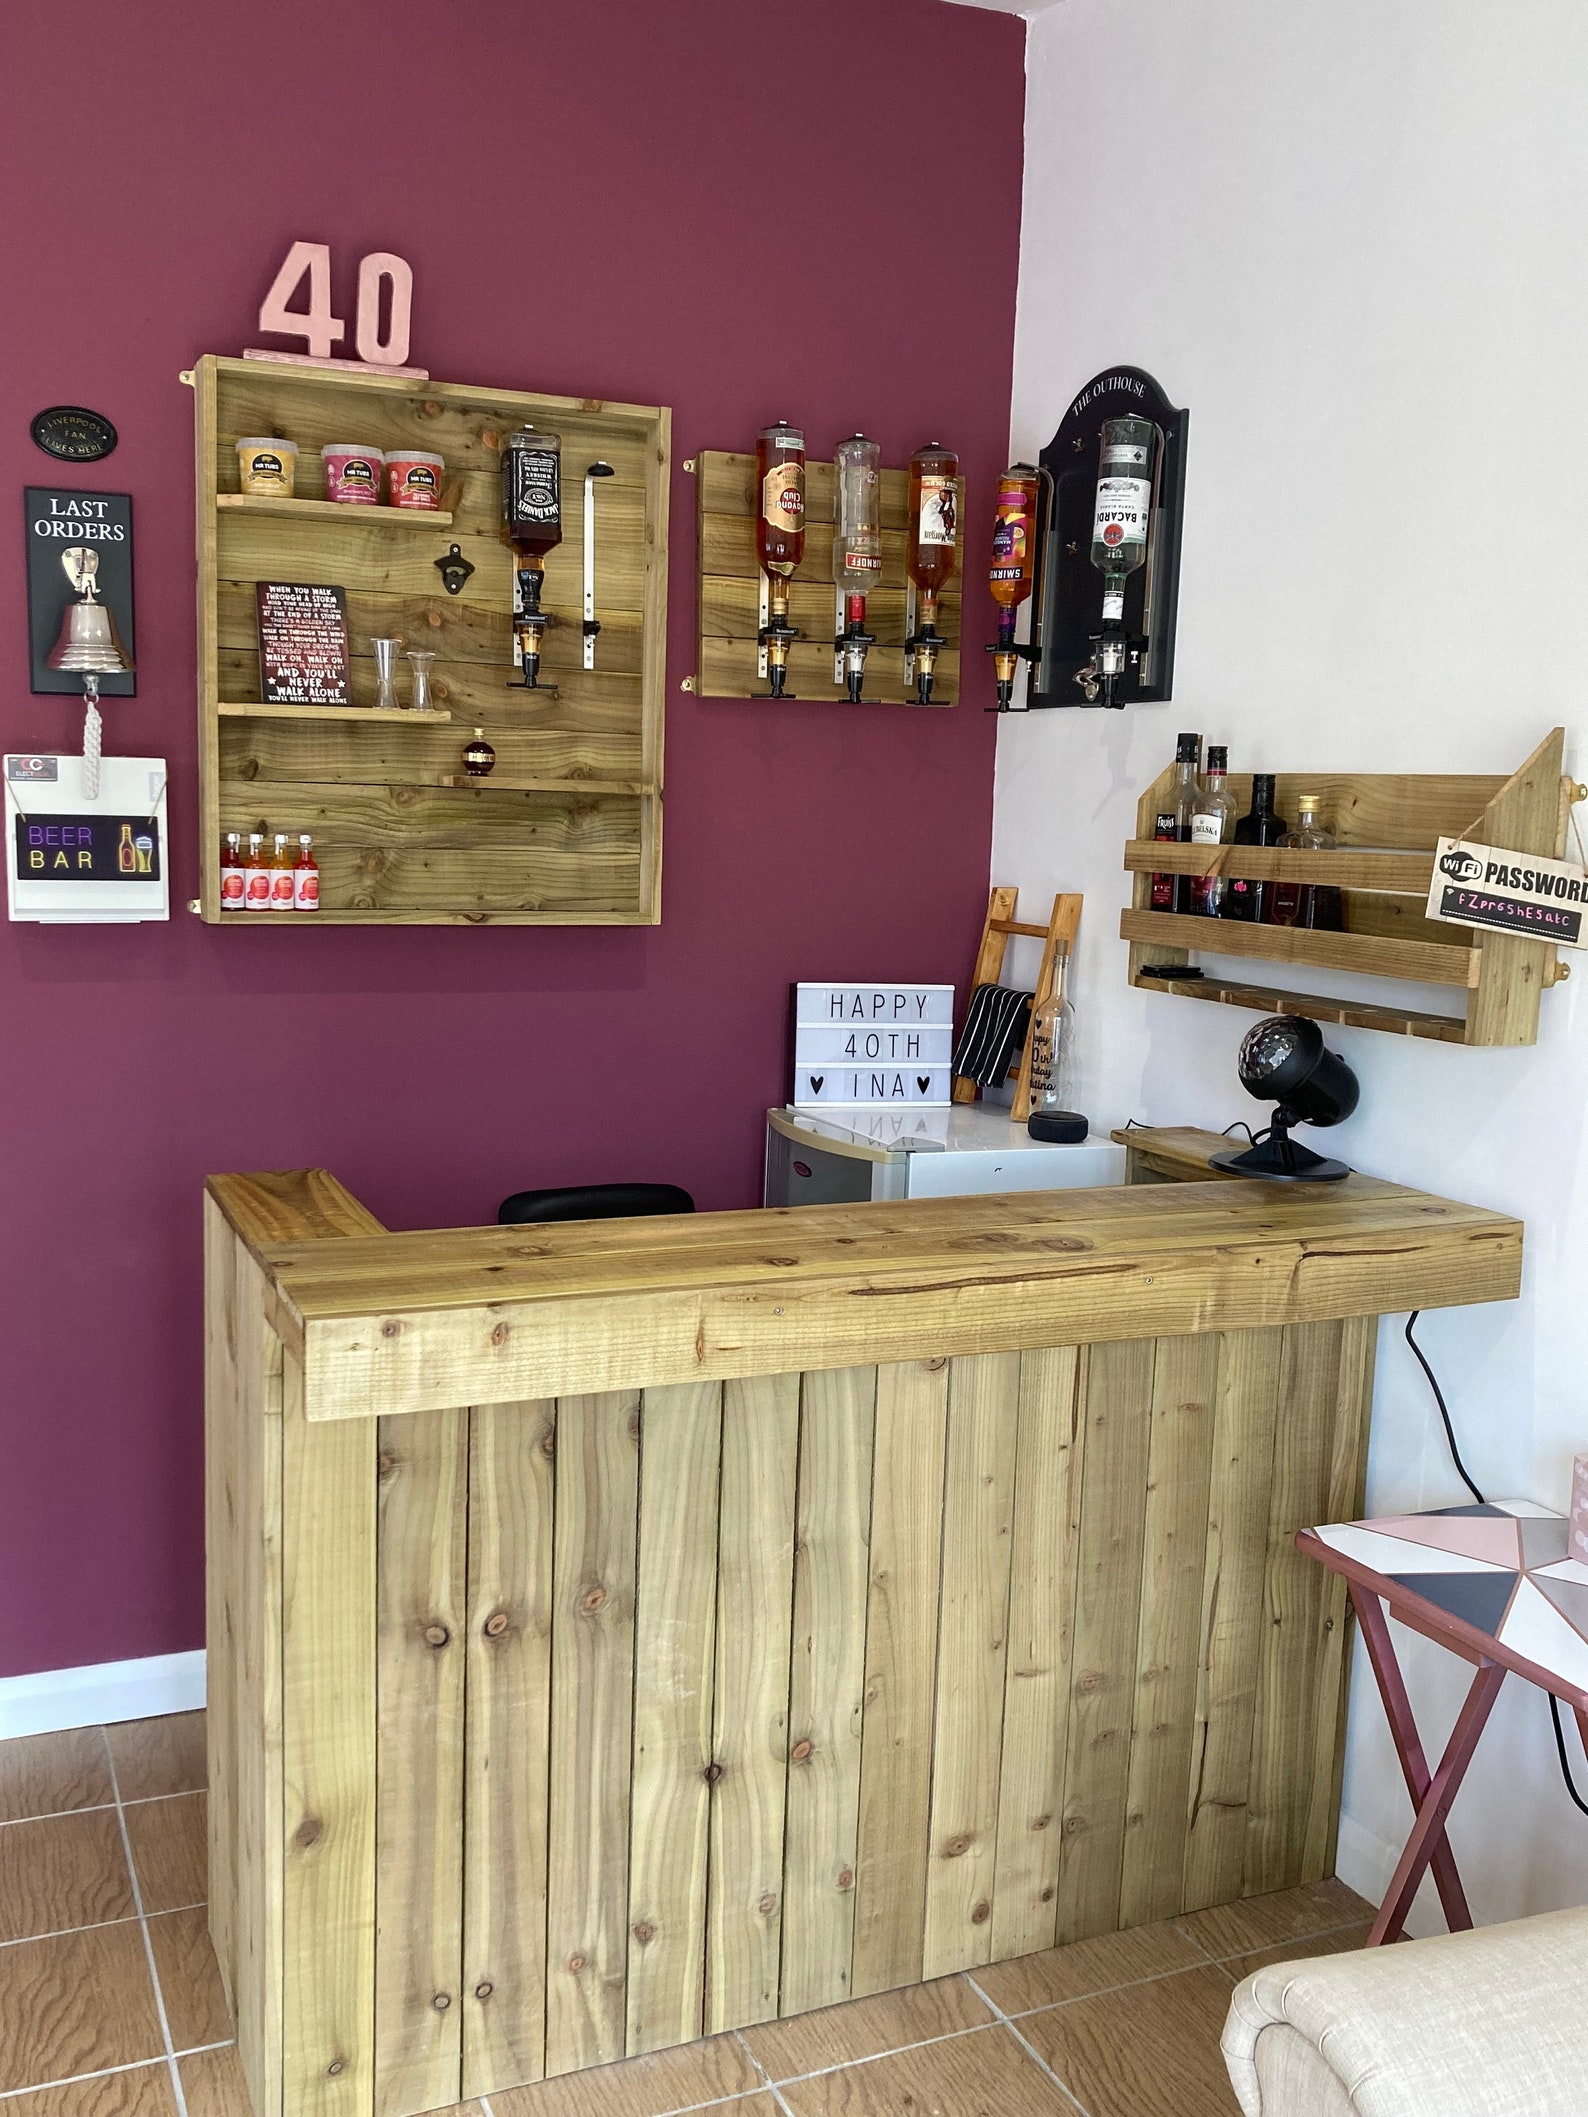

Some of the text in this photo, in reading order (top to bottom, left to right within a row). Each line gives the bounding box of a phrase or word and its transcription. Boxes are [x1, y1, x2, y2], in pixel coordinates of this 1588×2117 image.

[259, 241, 413, 366] 40
[1072, 376, 1147, 416] THE OUTHOUSE
[47, 416, 102, 433] LIVERPOOL
[64, 430, 87, 440] FAN
[45, 436, 104, 455] LIVES HERE
[784, 492, 800, 502] Club
[50, 498, 108, 518] LAST
[34, 519, 125, 541] ORDERS
[266, 593, 301, 601] THROUGH
[269, 585, 290, 593] WHEN
[307, 656, 328, 664] WALK
[278, 667, 337, 678] AND YOU'LL
[276, 686, 340, 697] WALK ALONE
[289, 678, 322, 687] NEVER
[29, 826, 92, 845] BEER
[30, 850, 92, 869] BAR
[1485, 862, 1588, 903] PASSWORD
[830, 994, 926, 1018] HAPPY
[854, 1074, 904, 1097] INA
